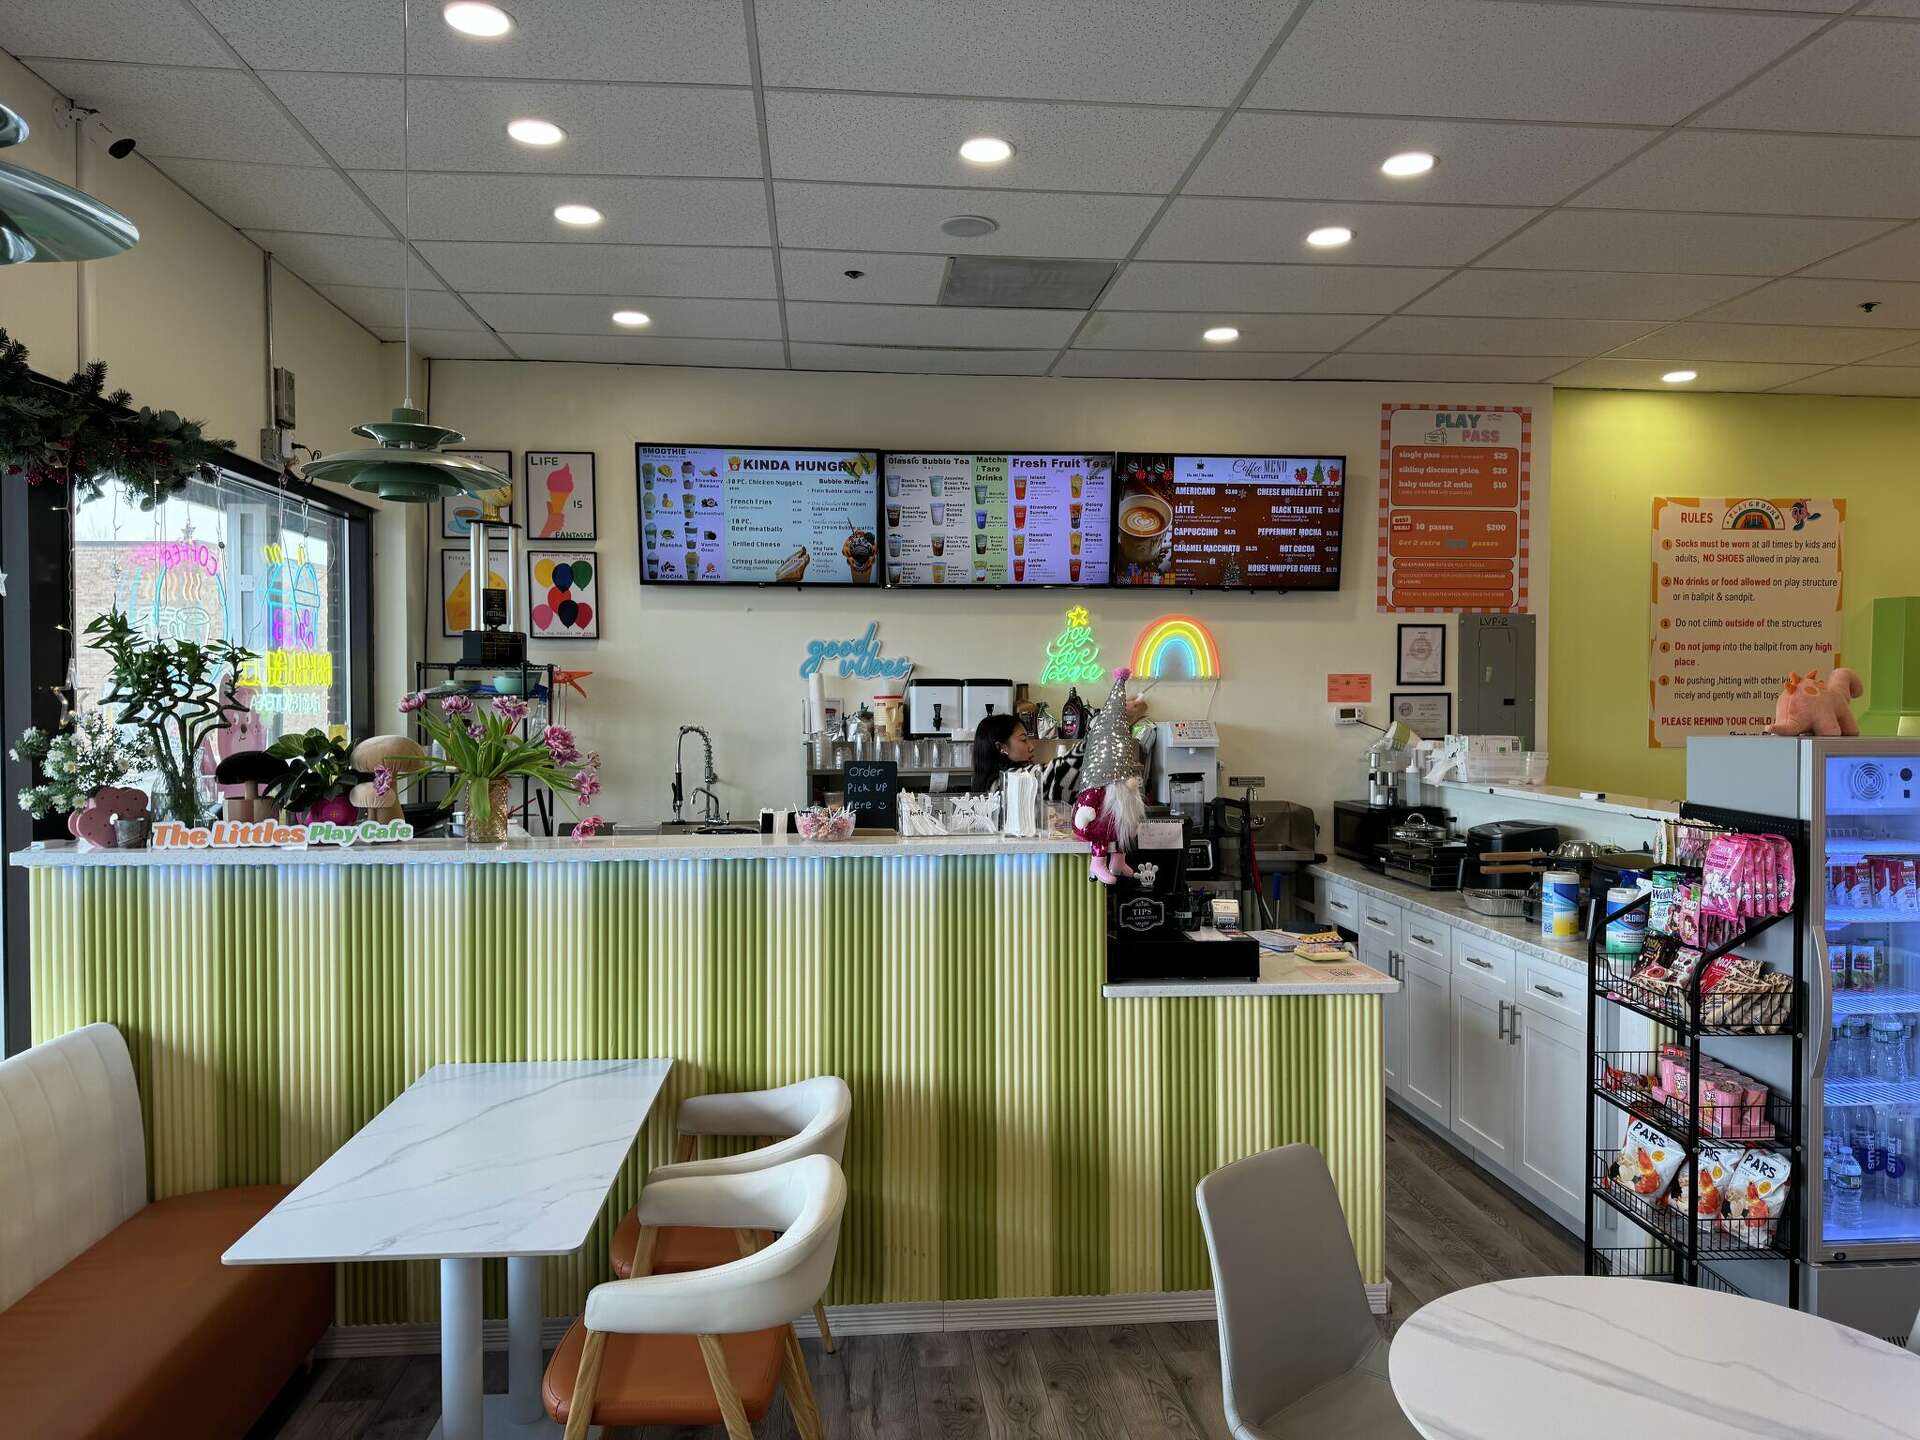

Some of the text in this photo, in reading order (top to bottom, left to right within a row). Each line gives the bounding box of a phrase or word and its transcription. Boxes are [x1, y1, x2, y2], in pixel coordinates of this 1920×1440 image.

[1436, 413, 1481, 428] PLAY
[1462, 430, 1500, 442] PASS
[531, 456, 559, 466] LIFE
[744, 459, 858, 472] KINDA HUNGRY
[1012, 458, 1108, 468] Fresh Fruit Tea
[1232, 459, 1288, 475] Coffee MENU
[1398, 467, 1425, 475] sibling
[1398, 480, 1417, 489] baby
[1175, 487, 1216, 495] AMERICANO
[1257, 488, 1280, 496] CHEESE
[1305, 488, 1323, 496] LATTE
[573, 500, 583, 508] IS
[1175, 506, 1195, 514] LATTE
[1271, 506, 1323, 514] BLACK TEA LATTE
[1680, 500, 1780, 524] RULES PLAYGROUND
[1174, 528, 1218, 536] CAPPUCCINO
[1258, 528, 1322, 536] PEPPERMINT MOCHA
[1428, 524, 1454, 532] passes
[1486, 524, 1506, 532] $200
[555, 531, 593, 539] FANTASTIC
[1173, 544, 1240, 552] CARAMEL MACCHIATO
[1280, 545, 1315, 553] HOT COCOA
[1675, 539, 1698, 548] Socks
[1700, 540, 1719, 548] must
[1720, 540, 1730, 548] be
[1751, 540, 1760, 549] at
[1761, 540, 1770, 549] all
[1772, 540, 1793, 549] times
[1794, 540, 1804, 552] by
[1805, 540, 1820, 549] kids
[1822, 540, 1836, 550] and
[1675, 554, 1700, 564] adults,
[1702, 554, 1715, 563] NO
[1716, 554, 1744, 563] SHOES
[1746, 554, 1775, 564] allowed
[1776, 555, 1784, 564] in
[1785, 555, 1801, 566] play
[1248, 564, 1322, 573] HOUSE WHIPPED COFFEE
[1673, 578, 1684, 586] No
[1686, 578, 1709, 586] drinks
[1720, 578, 1738, 586] food
[1740, 578, 1771, 586] allowed
[1784, 578, 1800, 589] play
[1802, 579, 1838, 587] structure
[1682, 592, 1690, 601] in
[1691, 592, 1714, 603] ballpit
[1716, 592, 1723, 601] &
[1724, 592, 1756, 603] sandpit.
[1675, 618, 1823, 628] Do not climb outside of the structures
[1056, 626, 1094, 648] joy
[800, 621, 878, 679] good
[1674, 642, 1832, 653] Do not jump into the ballpit from any high
[1046, 642, 1100, 665] love
[839, 641, 912, 678] vibes
[1674, 658, 1696, 668] place
[1040, 659, 1106, 685] peace
[1674, 676, 1686, 685] No
[1686, 676, 1715, 687] pushing
[1744, 676, 1759, 685] with
[1760, 676, 1780, 685] other
[1674, 690, 1779, 701] nicely and gently with all toys
[1662, 717, 1772, 726] PLEASE REMIND YOUR CHILD
[848, 765, 884, 777] Order
[154, 821, 413, 848] The Littles Play Cafe
[1132, 908, 1152, 916] TIPS
[1632, 1121, 1666, 1148] PARS
[1887, 1136, 1897, 1174] smart
[1744, 1153, 1777, 1179] PARS
